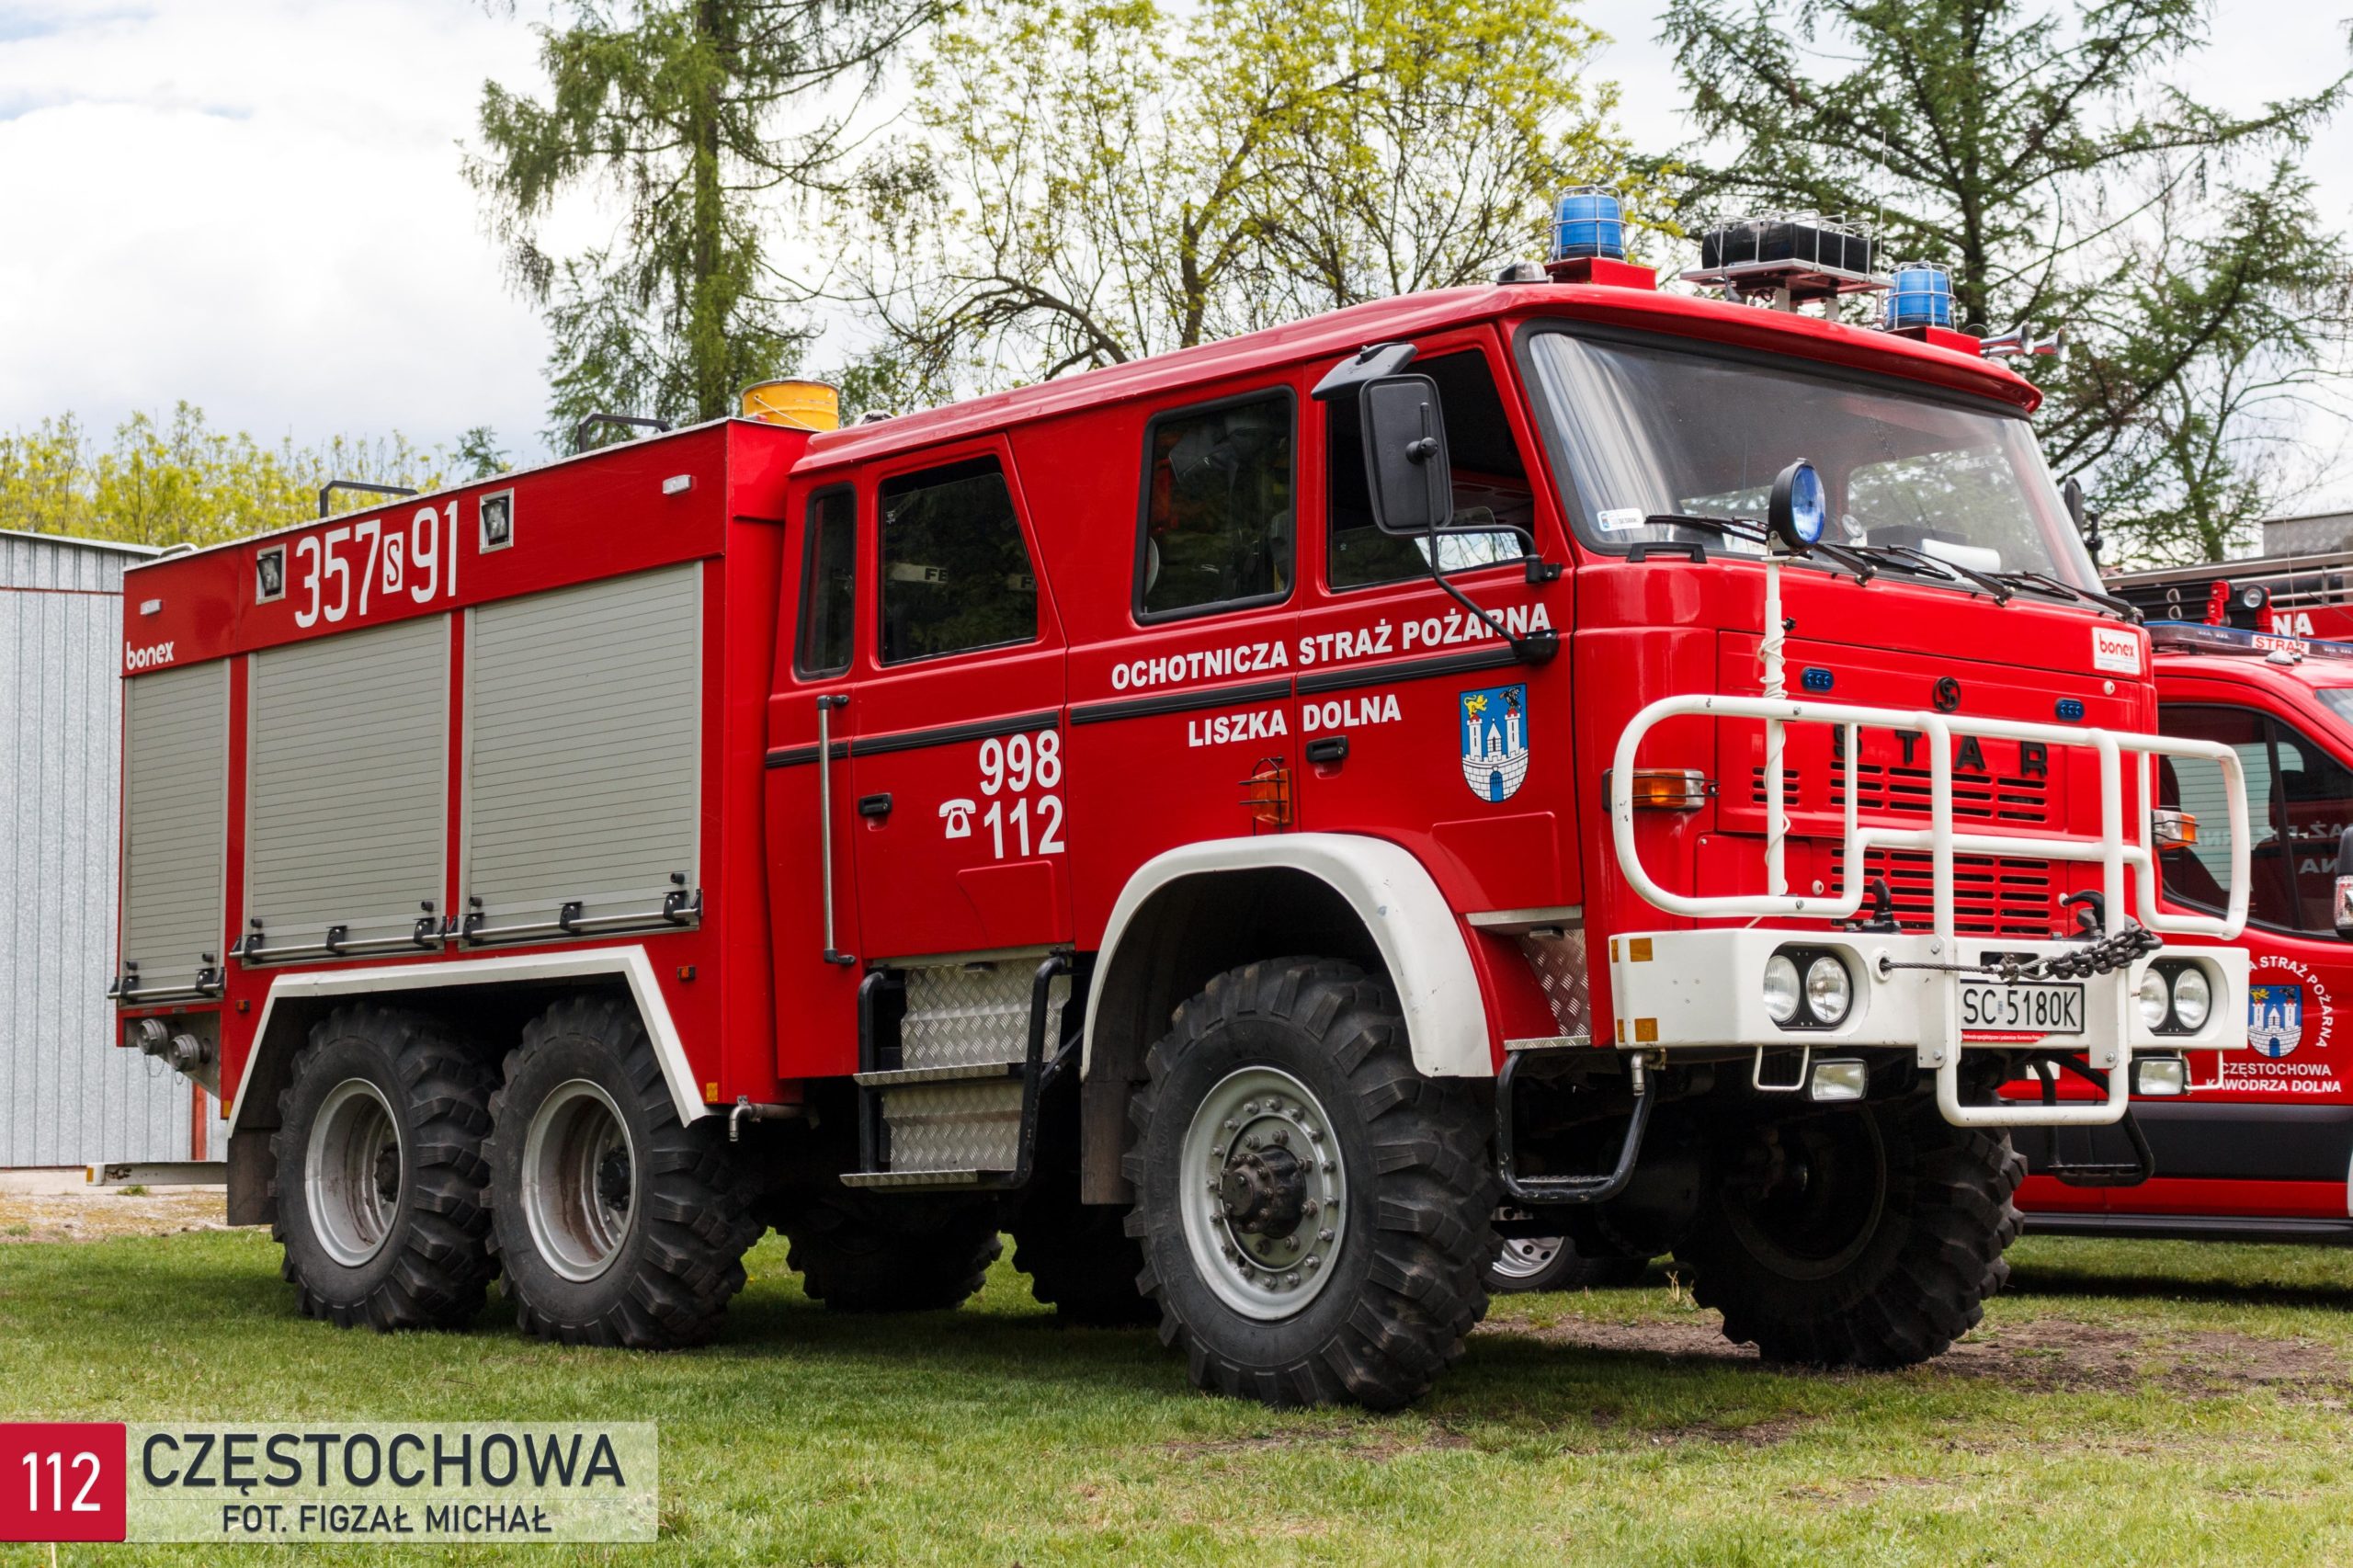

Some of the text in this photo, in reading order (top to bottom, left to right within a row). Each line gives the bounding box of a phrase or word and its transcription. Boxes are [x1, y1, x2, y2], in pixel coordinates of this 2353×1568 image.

[125, 641, 175, 671] bonex
[1111, 603, 1552, 691] OCHOTNICZA STRAŻ POŻARNA
[2098, 632, 2136, 658] bonex
[1188, 694, 1403, 748] LISZKA DOLNA
[979, 729, 1063, 796] 998
[983, 794, 1065, 860] 112
[1963, 988, 2077, 1028] SC 5180K
[2259, 956, 2308, 978] STRAŻ
[2306, 974, 2334, 1048] POŻARNA
[2222, 1062, 2332, 1077] CZĘSTOCHOWA
[2291, 1080, 2342, 1093] DOLNA
